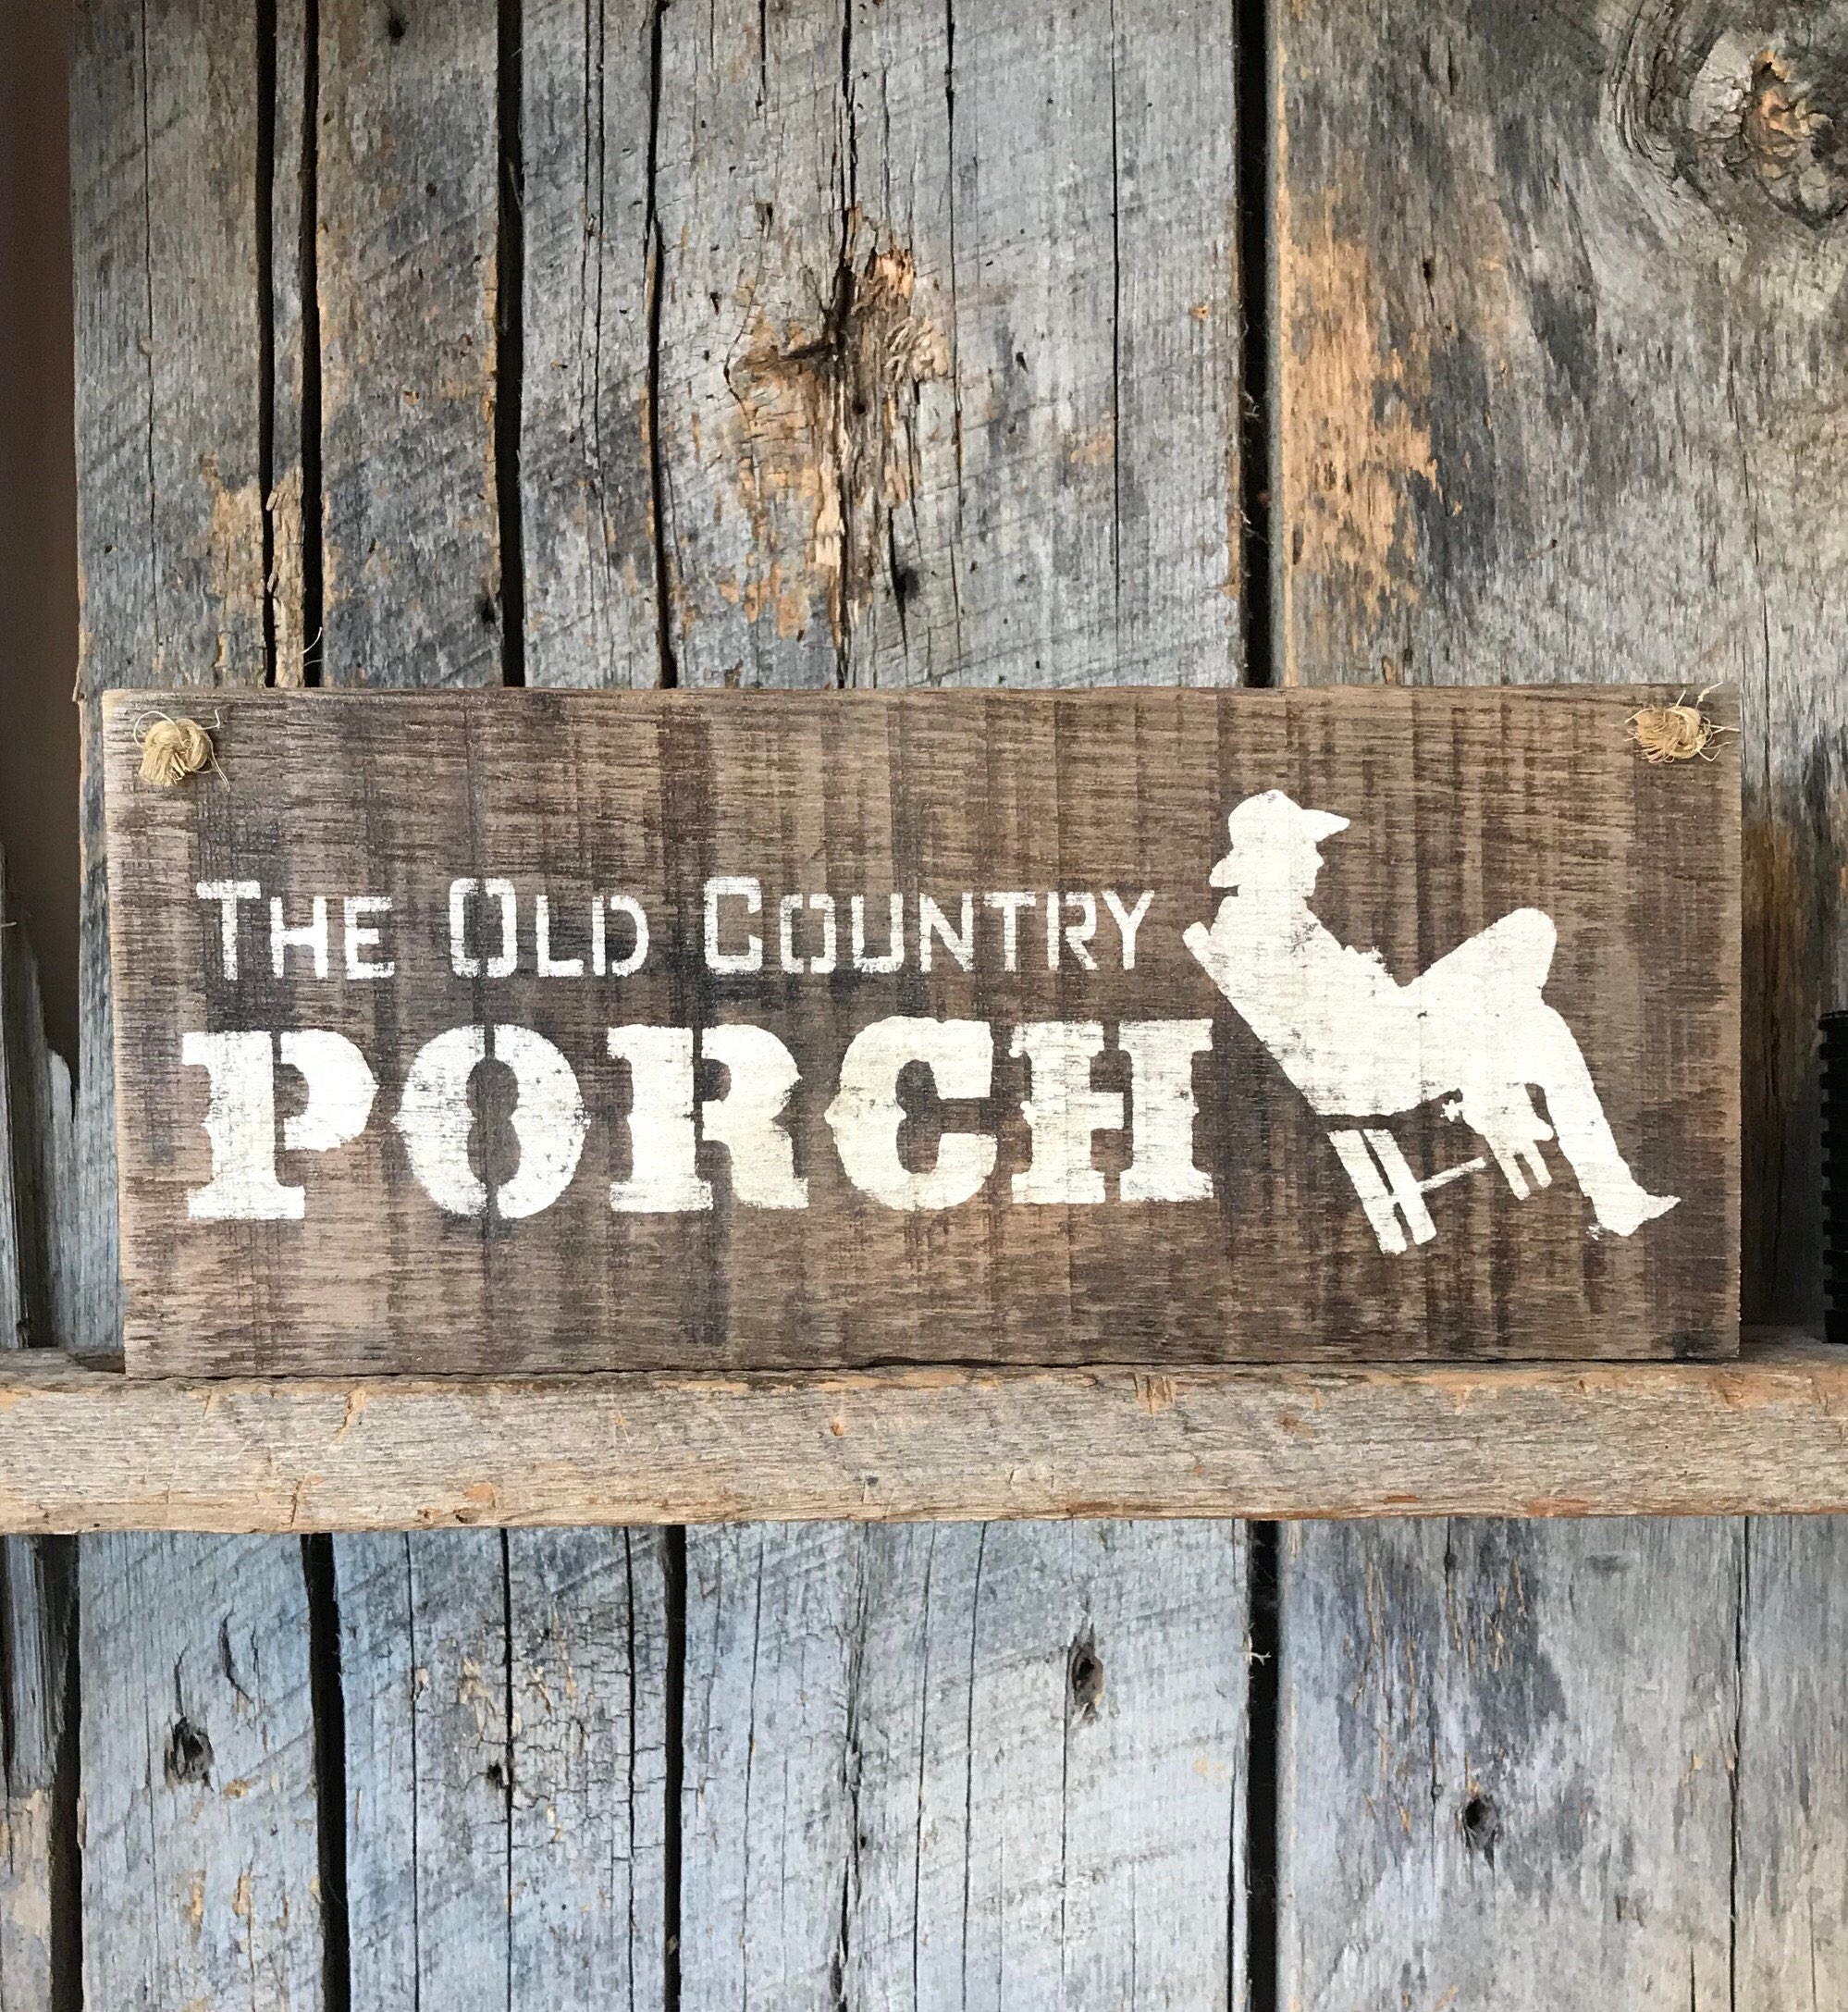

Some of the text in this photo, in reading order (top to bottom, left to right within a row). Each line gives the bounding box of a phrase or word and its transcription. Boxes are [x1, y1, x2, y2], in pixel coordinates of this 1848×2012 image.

[195, 875, 1156, 981] THE OLD COUNTRY
[180, 1016, 1214, 1222] PORCH
